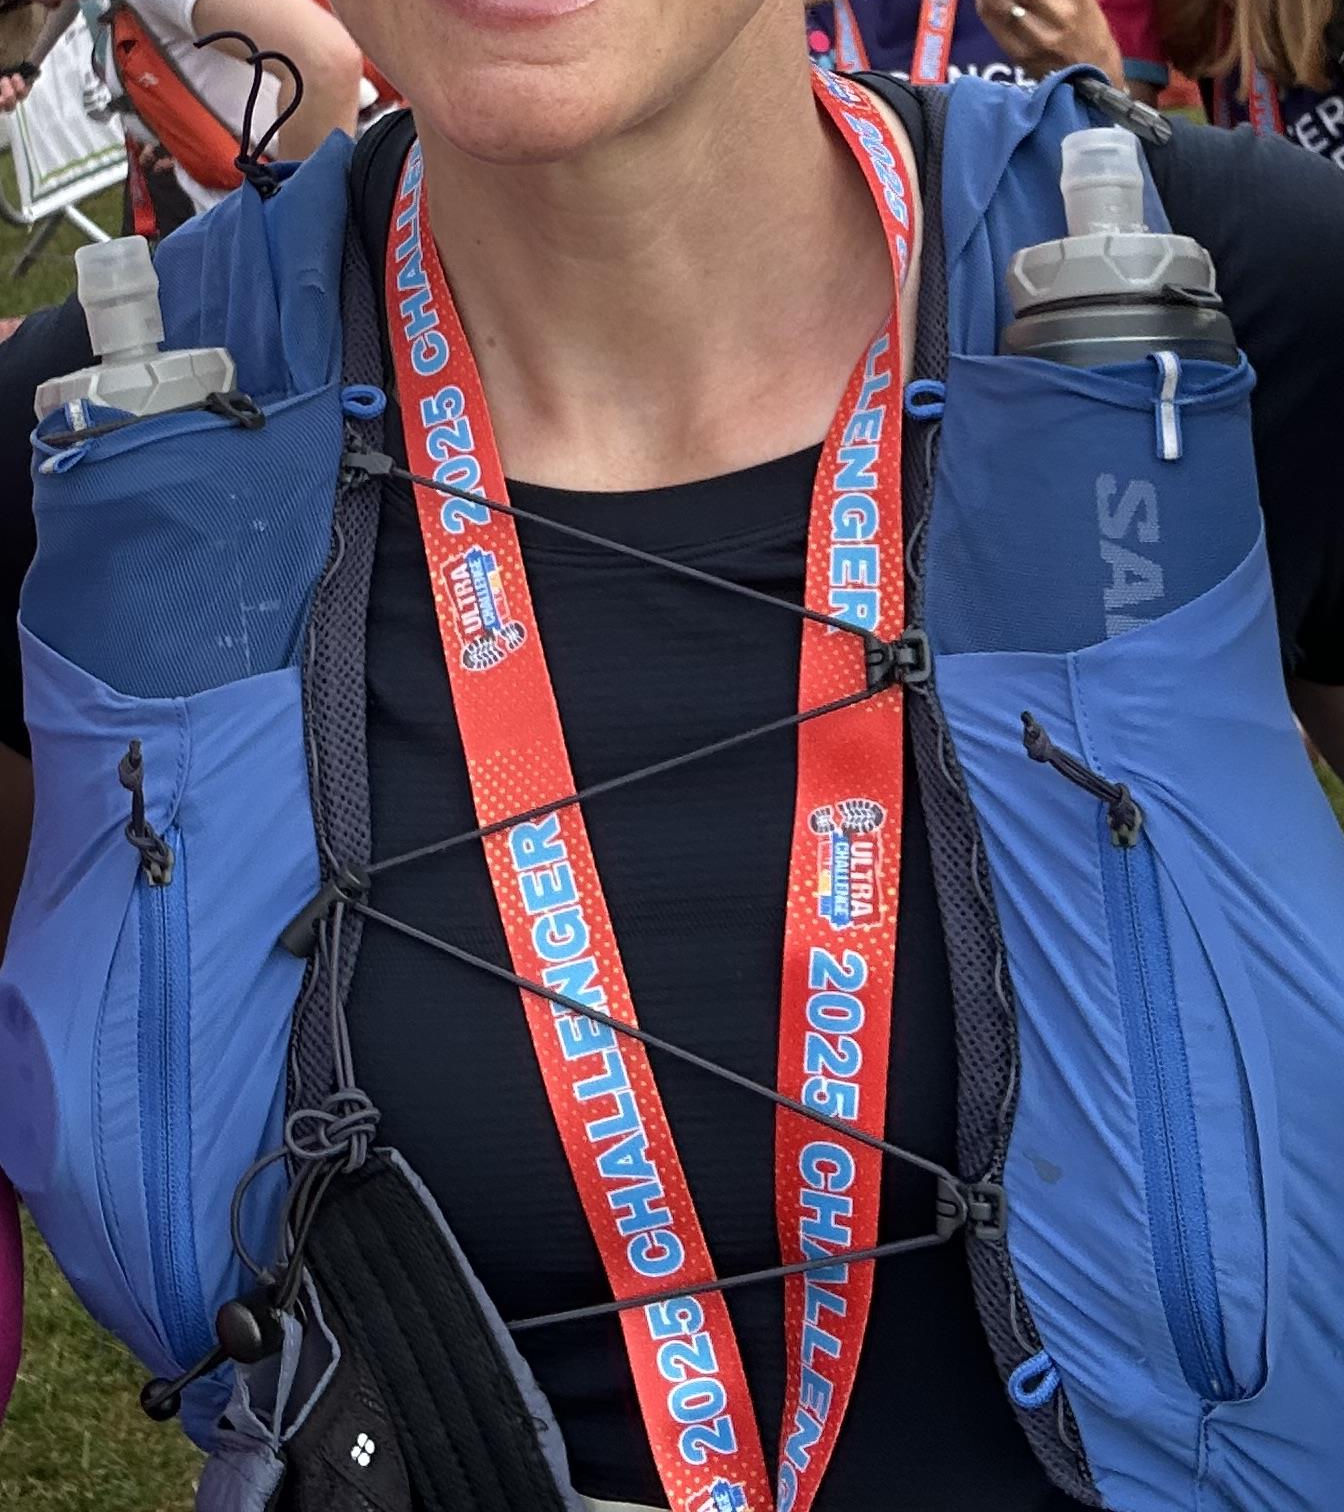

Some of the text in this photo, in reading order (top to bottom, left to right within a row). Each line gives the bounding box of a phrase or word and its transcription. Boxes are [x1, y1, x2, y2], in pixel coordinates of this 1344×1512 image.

[842, 110, 910, 231] 2025
[419, 384, 493, 535] 2025
[452, 561, 485, 636] ULTRA
[833, 841, 850, 917] CHALLENGE
[850, 841, 874, 918] ULTRA
[509, 813, 686, 1281] CHALLENGER
[801, 946, 870, 1123] 2025
[643, 1293, 739, 1466] 2025
